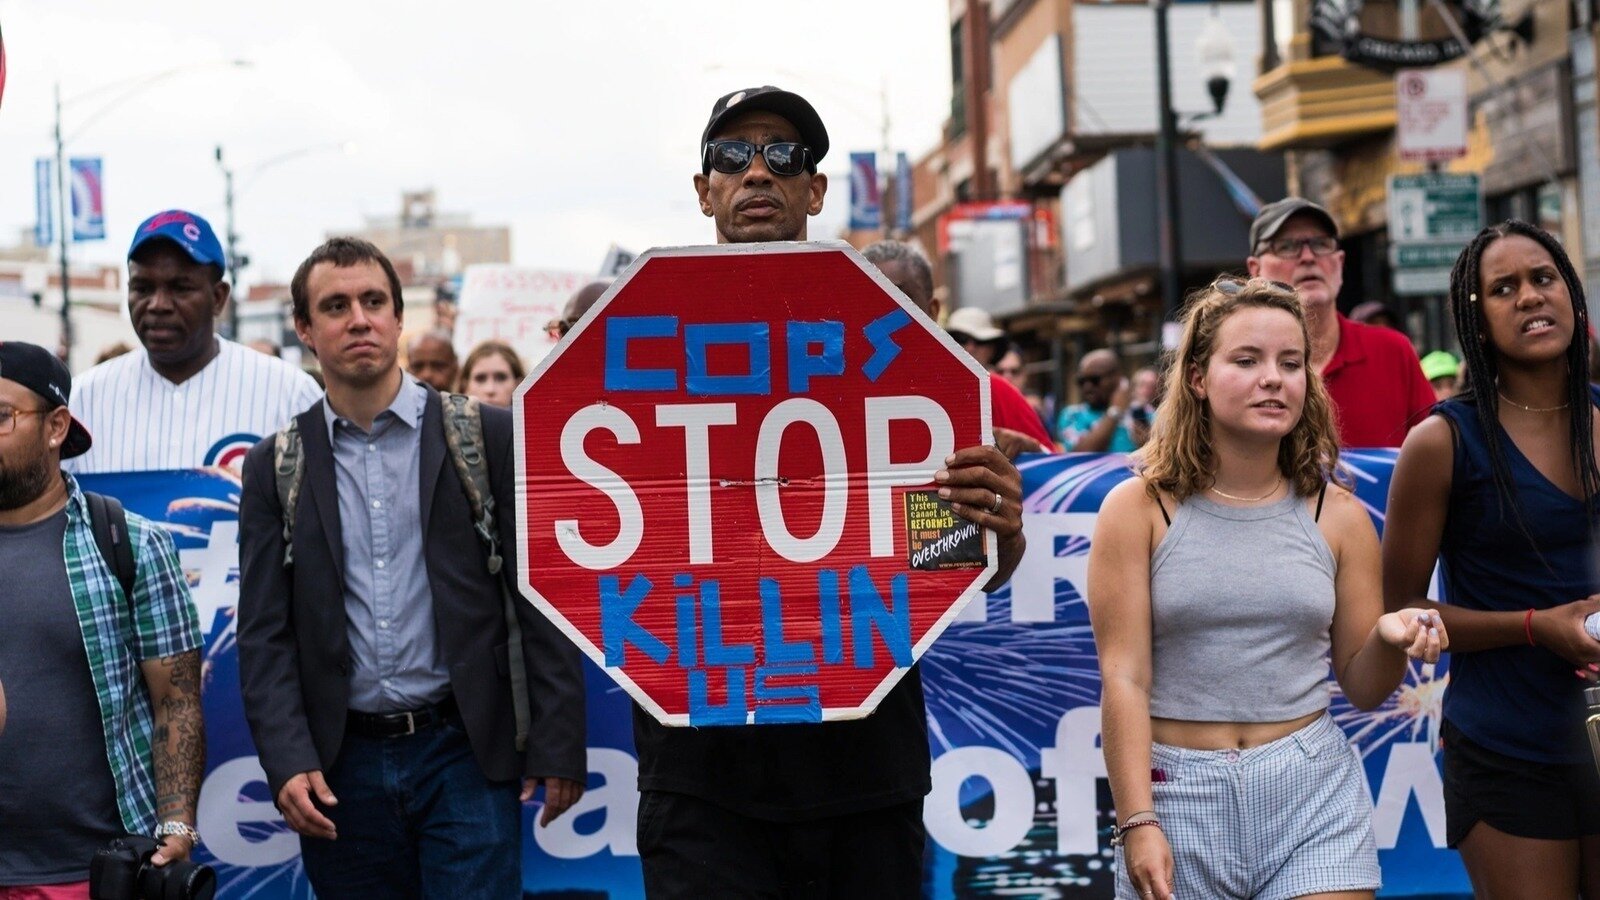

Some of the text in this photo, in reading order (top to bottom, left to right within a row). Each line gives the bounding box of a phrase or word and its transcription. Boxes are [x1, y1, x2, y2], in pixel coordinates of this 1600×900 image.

[554, 395, 957, 571] STOP
[910, 493, 929, 502] This
[910, 502, 938, 511] system
[910, 508, 950, 518] cannot be
[920, 529, 941, 540] must
[912, 540, 922, 550] be
[688, 663, 823, 727] US
